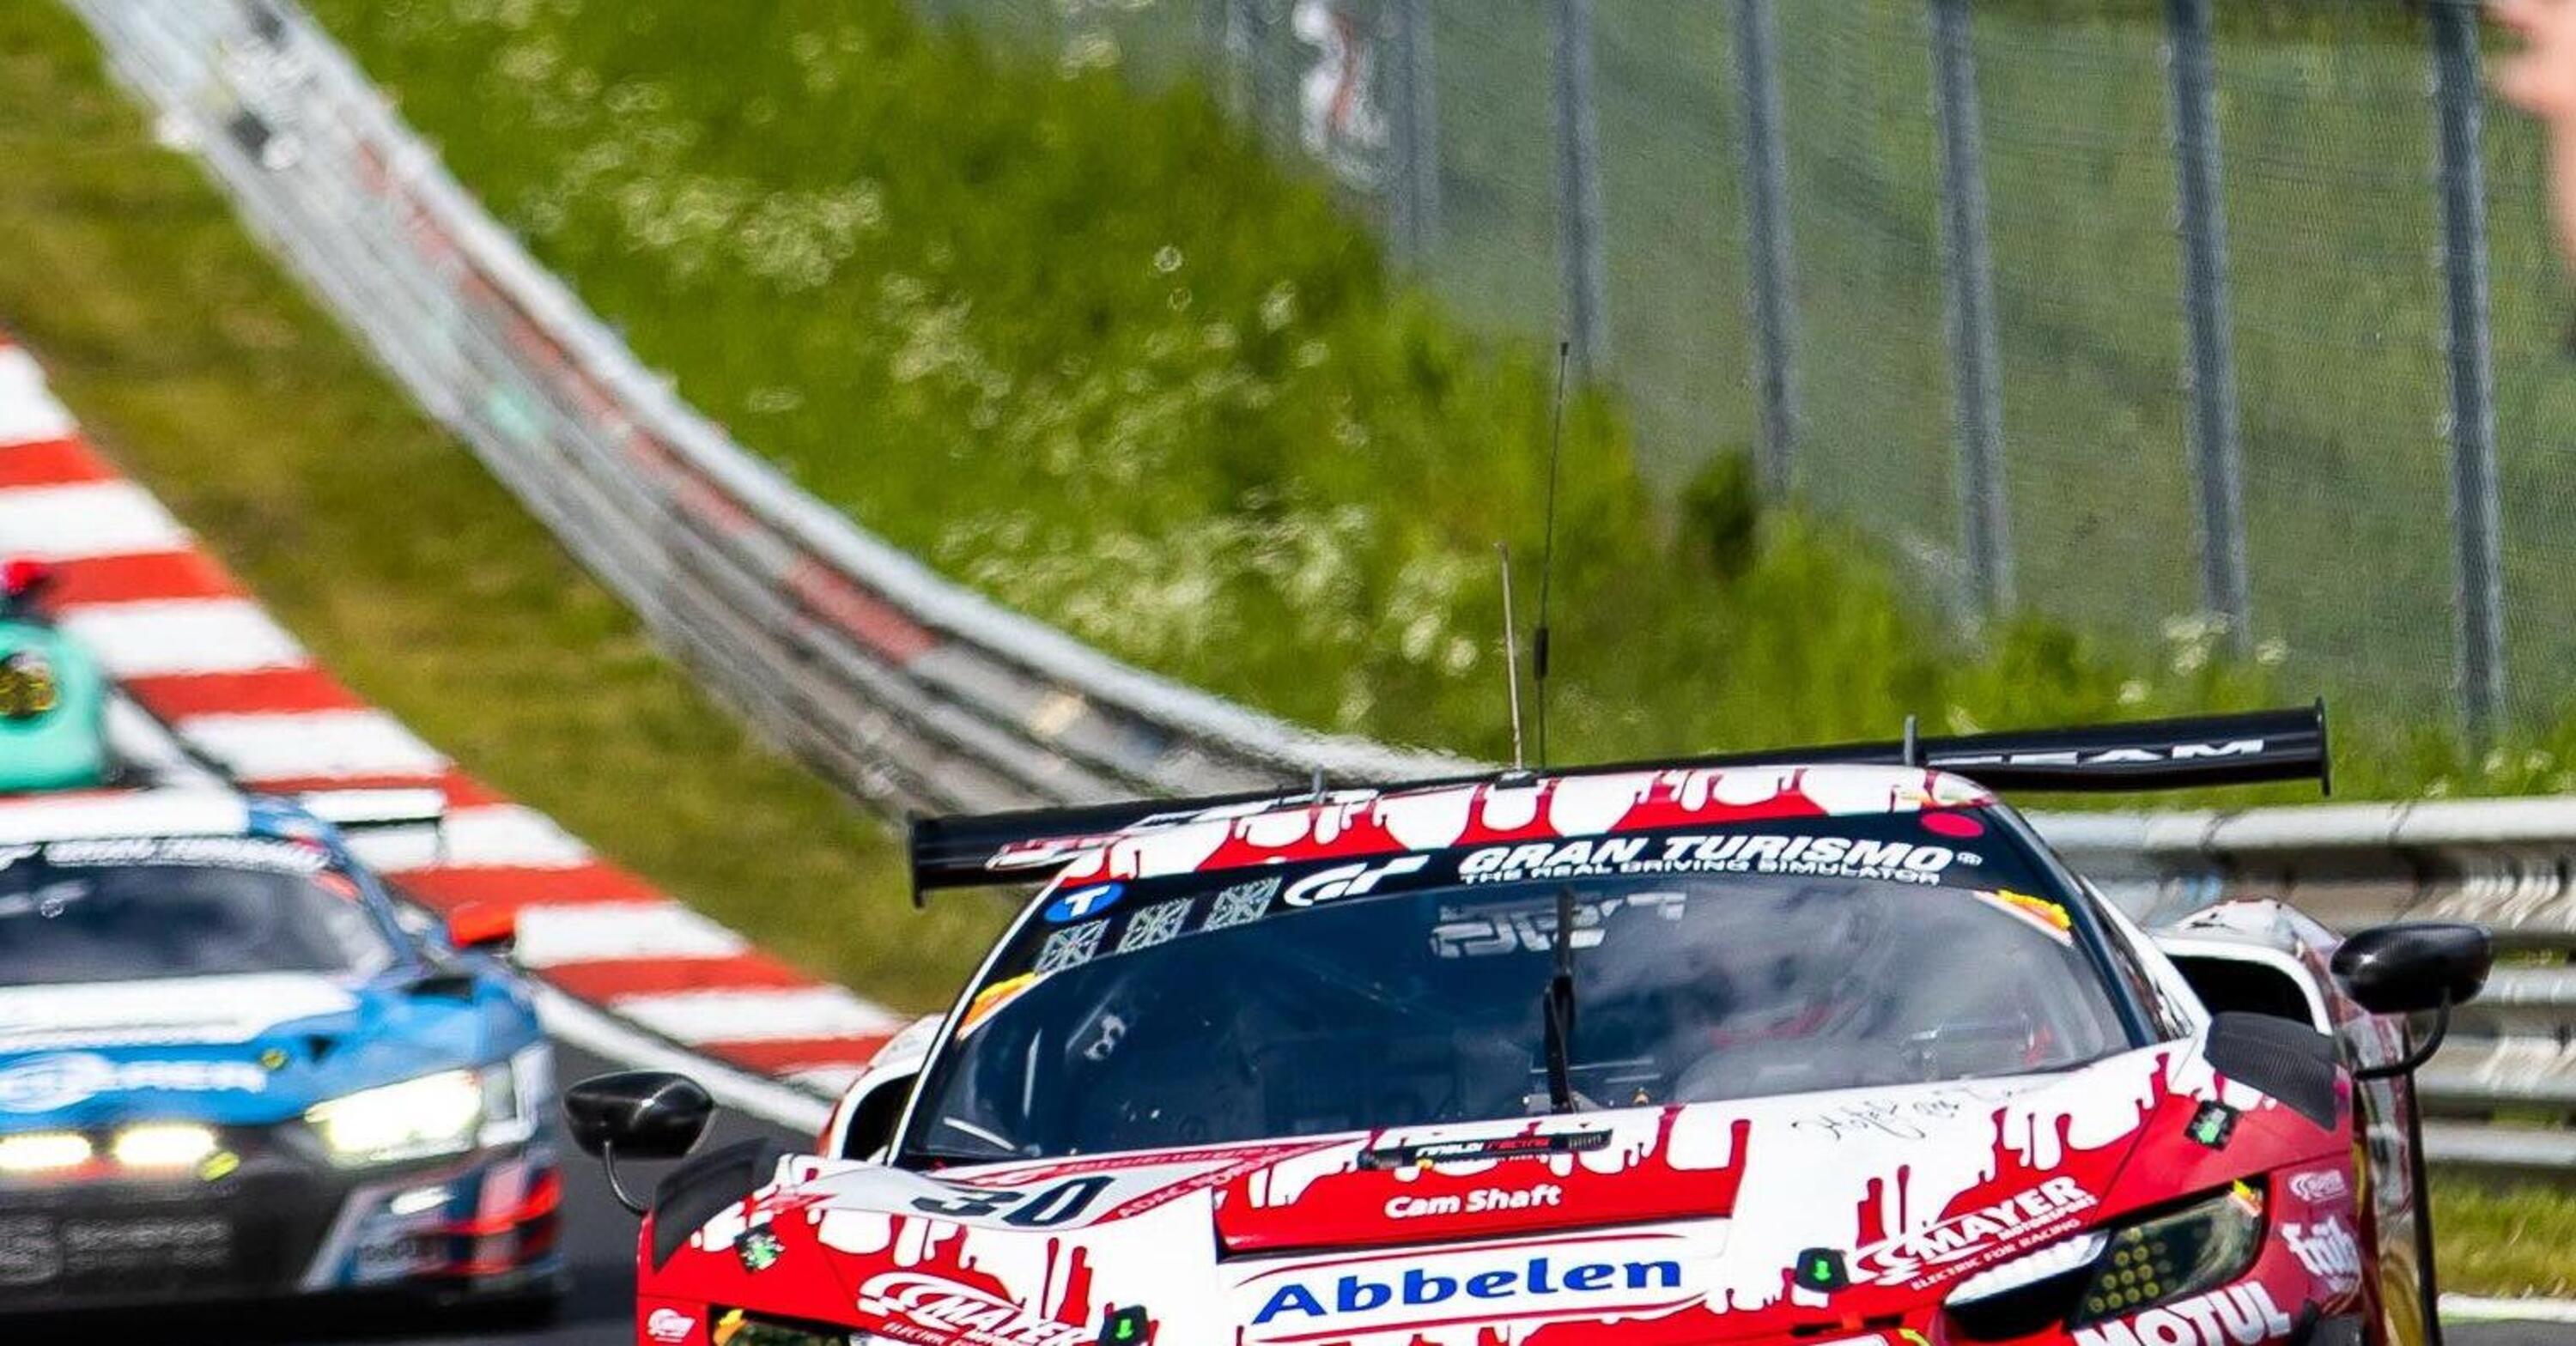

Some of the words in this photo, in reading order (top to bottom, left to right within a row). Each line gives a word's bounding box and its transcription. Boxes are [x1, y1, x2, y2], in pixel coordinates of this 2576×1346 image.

[1458, 836, 1649, 876] GRAN
[1460, 868, 1523, 885] THE
[1532, 862, 1613, 879] REAL
[1620, 858, 1750, 873] DRIVING
[1757, 859, 1941, 886] SIMULATOR
[1384, 1195, 1461, 1219] Cam
[1465, 1183, 1563, 1213] Shaft
[1917, 1175, 2089, 1262] MAYER
[1911, 1257, 1981, 1291] ELECTRIC
[1983, 1244, 2017, 1262] FOR
[2018, 1218, 2081, 1247] RACING
[1251, 1257, 1681, 1325] Abbelen
